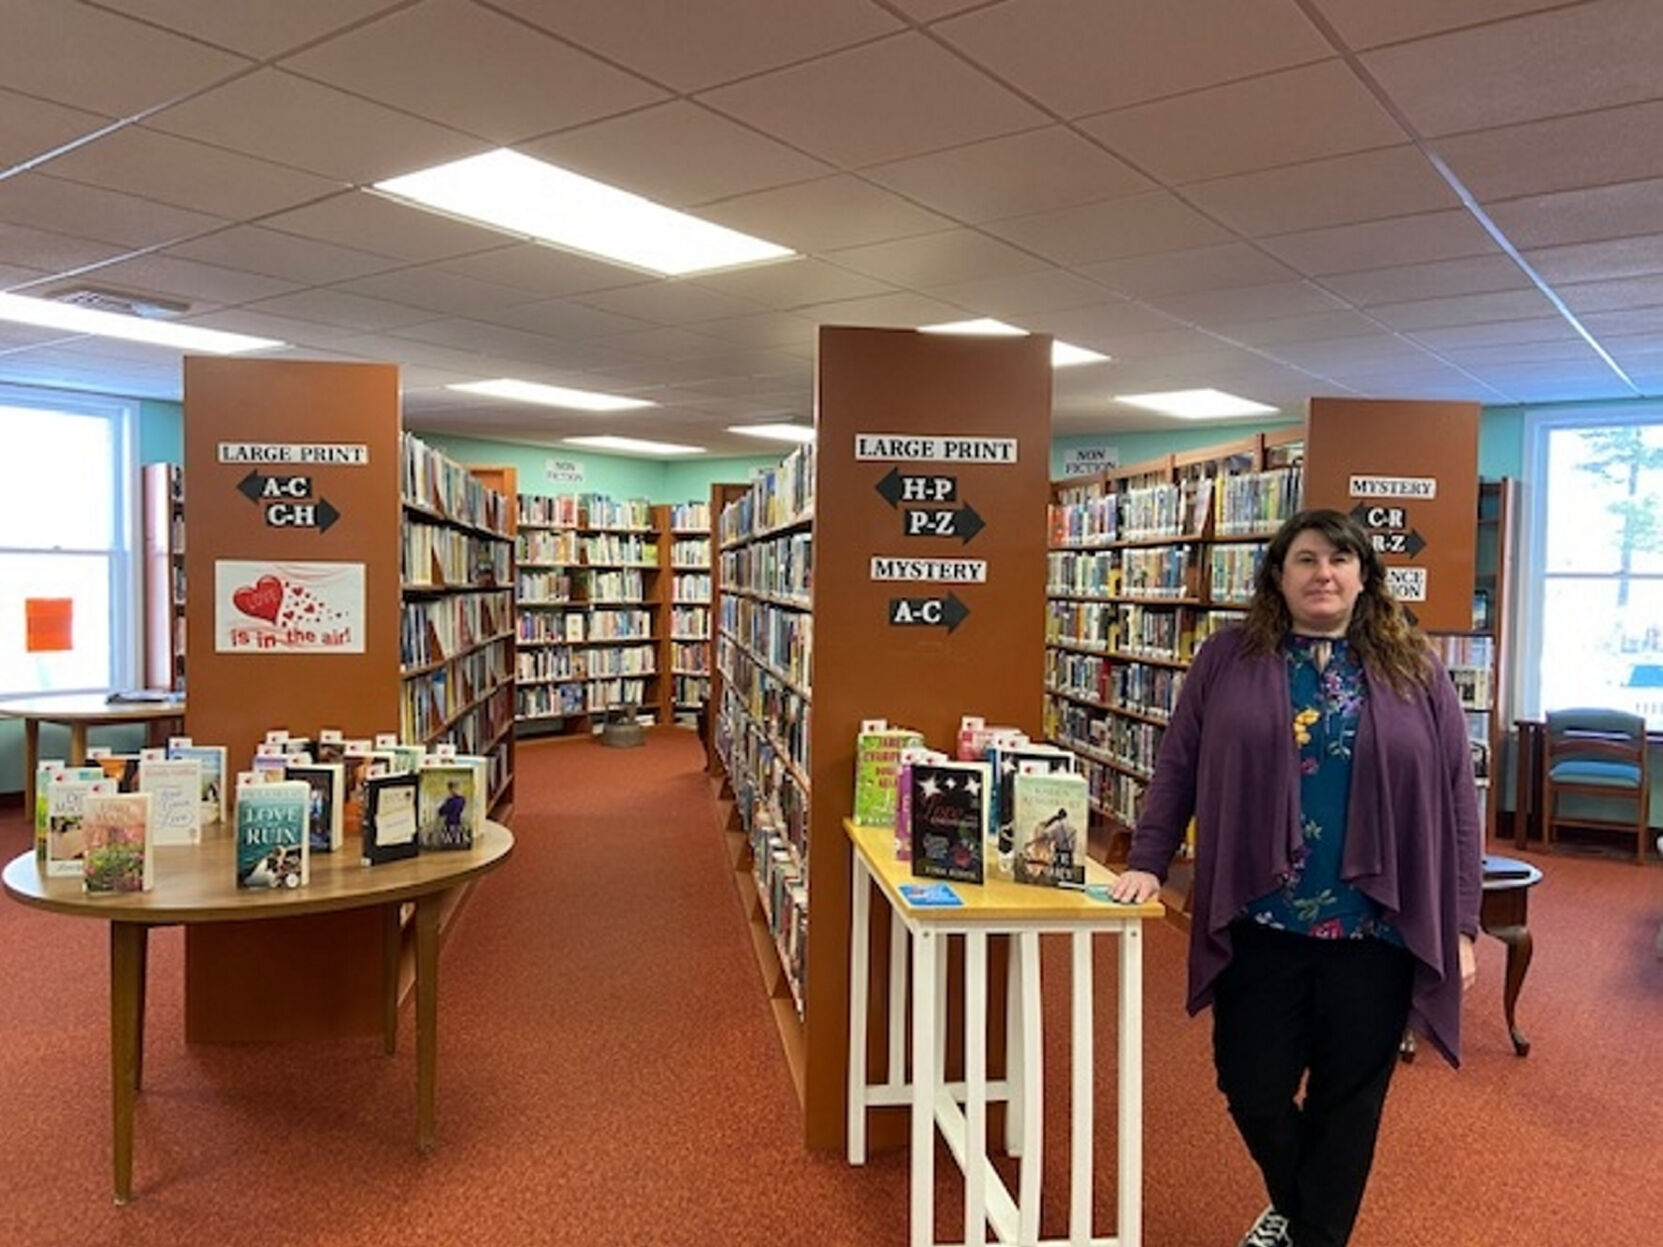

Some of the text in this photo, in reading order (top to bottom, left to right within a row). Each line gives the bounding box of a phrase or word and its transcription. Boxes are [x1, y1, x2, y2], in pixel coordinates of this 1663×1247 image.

[222, 445, 364, 462] LARGE PRINT
[859, 438, 1013, 460] LARGE PRINT
[1077, 450, 1106, 461] NON
[262, 477, 307, 497] A-C
[902, 477, 952, 501] H-P
[1352, 480, 1432, 495] MYSTERY
[268, 504, 315, 526] C-H
[909, 511, 955, 535] P-Z
[1367, 507, 1403, 528] C-R
[1372, 535, 1406, 552] R-Z
[875, 560, 982, 580] MYSTERY
[893, 601, 942, 623] A-C
[230, 629, 250, 647] is
[256, 631, 277, 648] in
[286, 628, 316, 644] the
[245, 807, 297, 823] LOVE
[245, 827, 297, 845] RUIN
